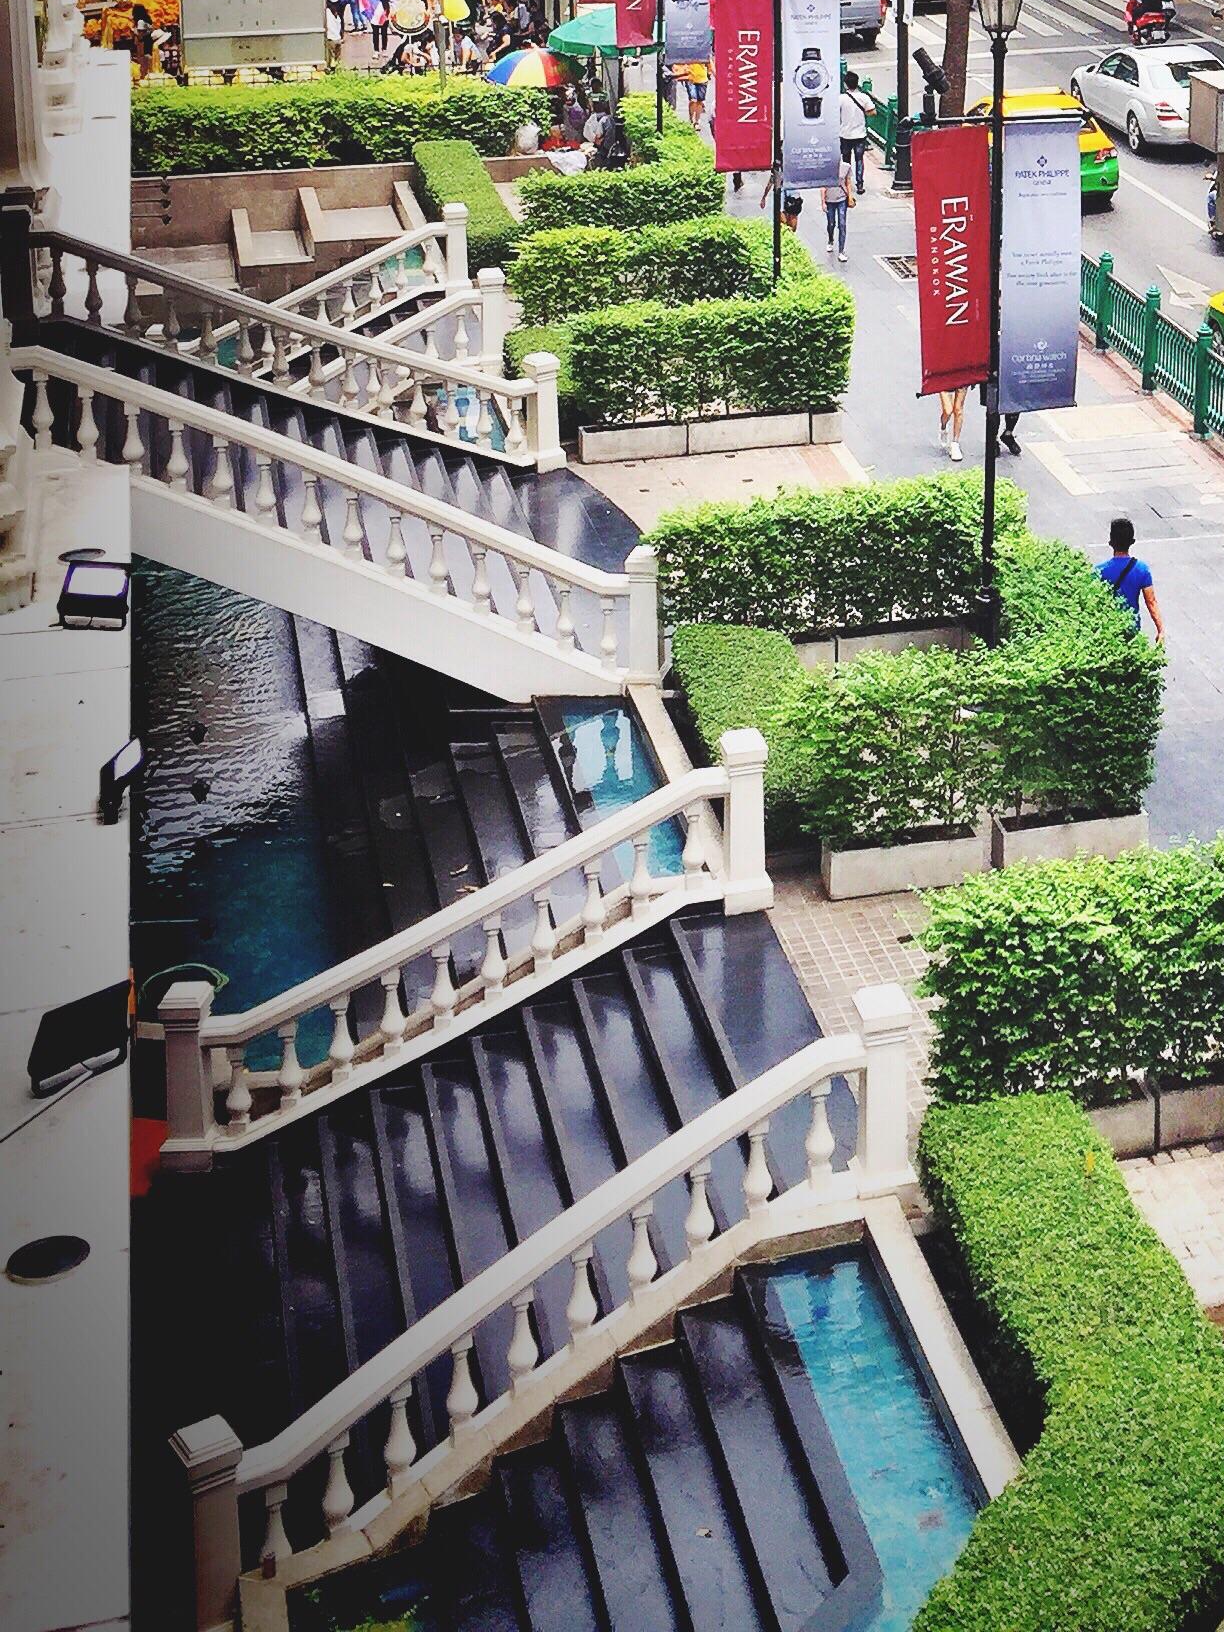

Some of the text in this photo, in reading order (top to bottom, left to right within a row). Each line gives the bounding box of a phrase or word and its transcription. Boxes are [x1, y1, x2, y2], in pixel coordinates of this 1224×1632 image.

[735, 30, 761, 124] ERAWAN
[929, 226, 941, 297] BANGKOK
[939, 196, 969, 327] ERAWAN
